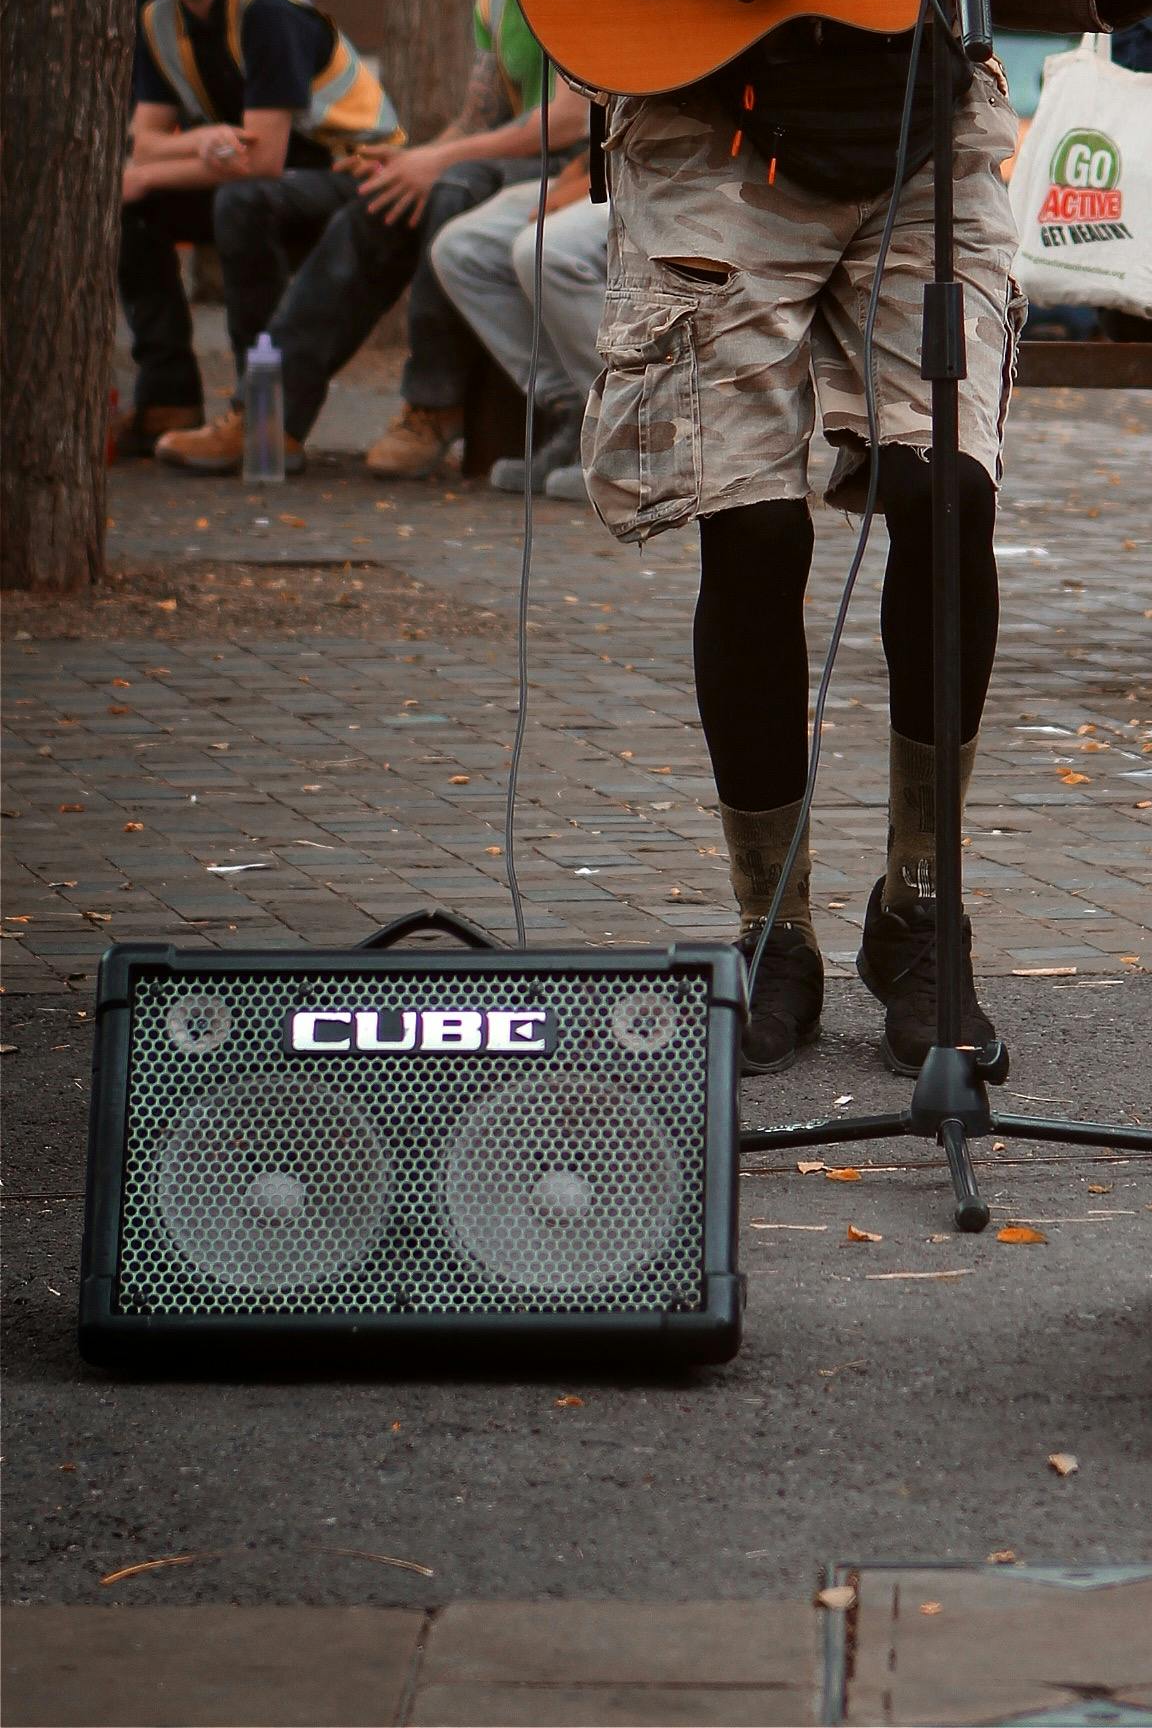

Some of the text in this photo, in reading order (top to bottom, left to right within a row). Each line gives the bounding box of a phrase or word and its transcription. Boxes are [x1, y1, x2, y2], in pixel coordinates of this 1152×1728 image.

[1064, 143, 1113, 189] GO
[1040, 185, 1122, 222] ACTIVE
[1041, 222, 1134, 248] GET HEALTHY
[292, 1011, 546, 1051] CUBE
